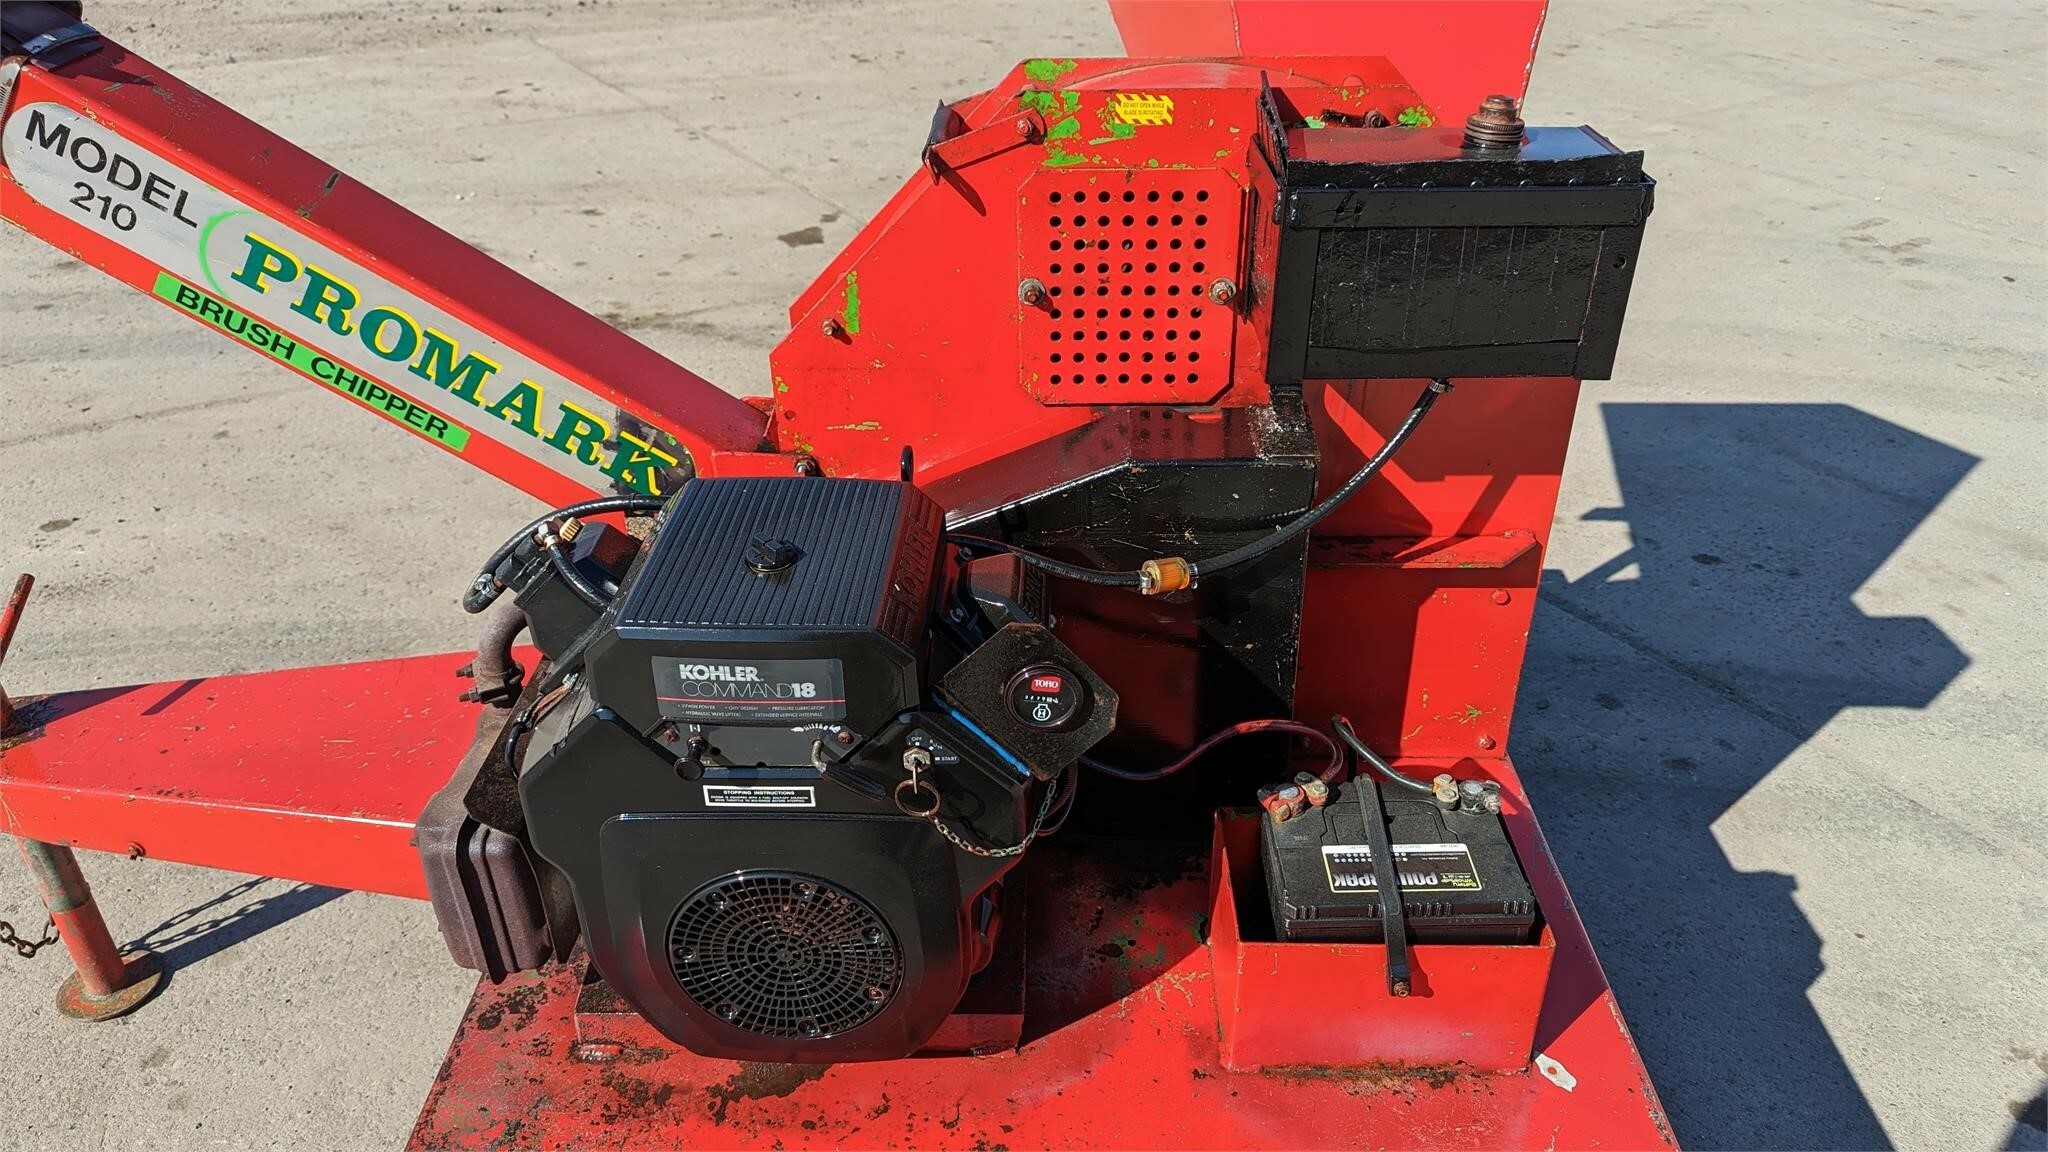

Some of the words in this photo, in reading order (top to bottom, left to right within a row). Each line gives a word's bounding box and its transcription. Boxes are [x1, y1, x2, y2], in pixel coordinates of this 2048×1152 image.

[25, 109, 198, 229] MODEL
[69, 181, 138, 232] 210
[175, 284, 297, 361] BRUSH
[310, 356, 450, 440] CHIPPER
[230, 231, 678, 496] PROMARK
[679, 664, 761, 682] KOHLER
[1034, 679, 1059, 688] TORO
[930, 739, 943, 750] RUN
